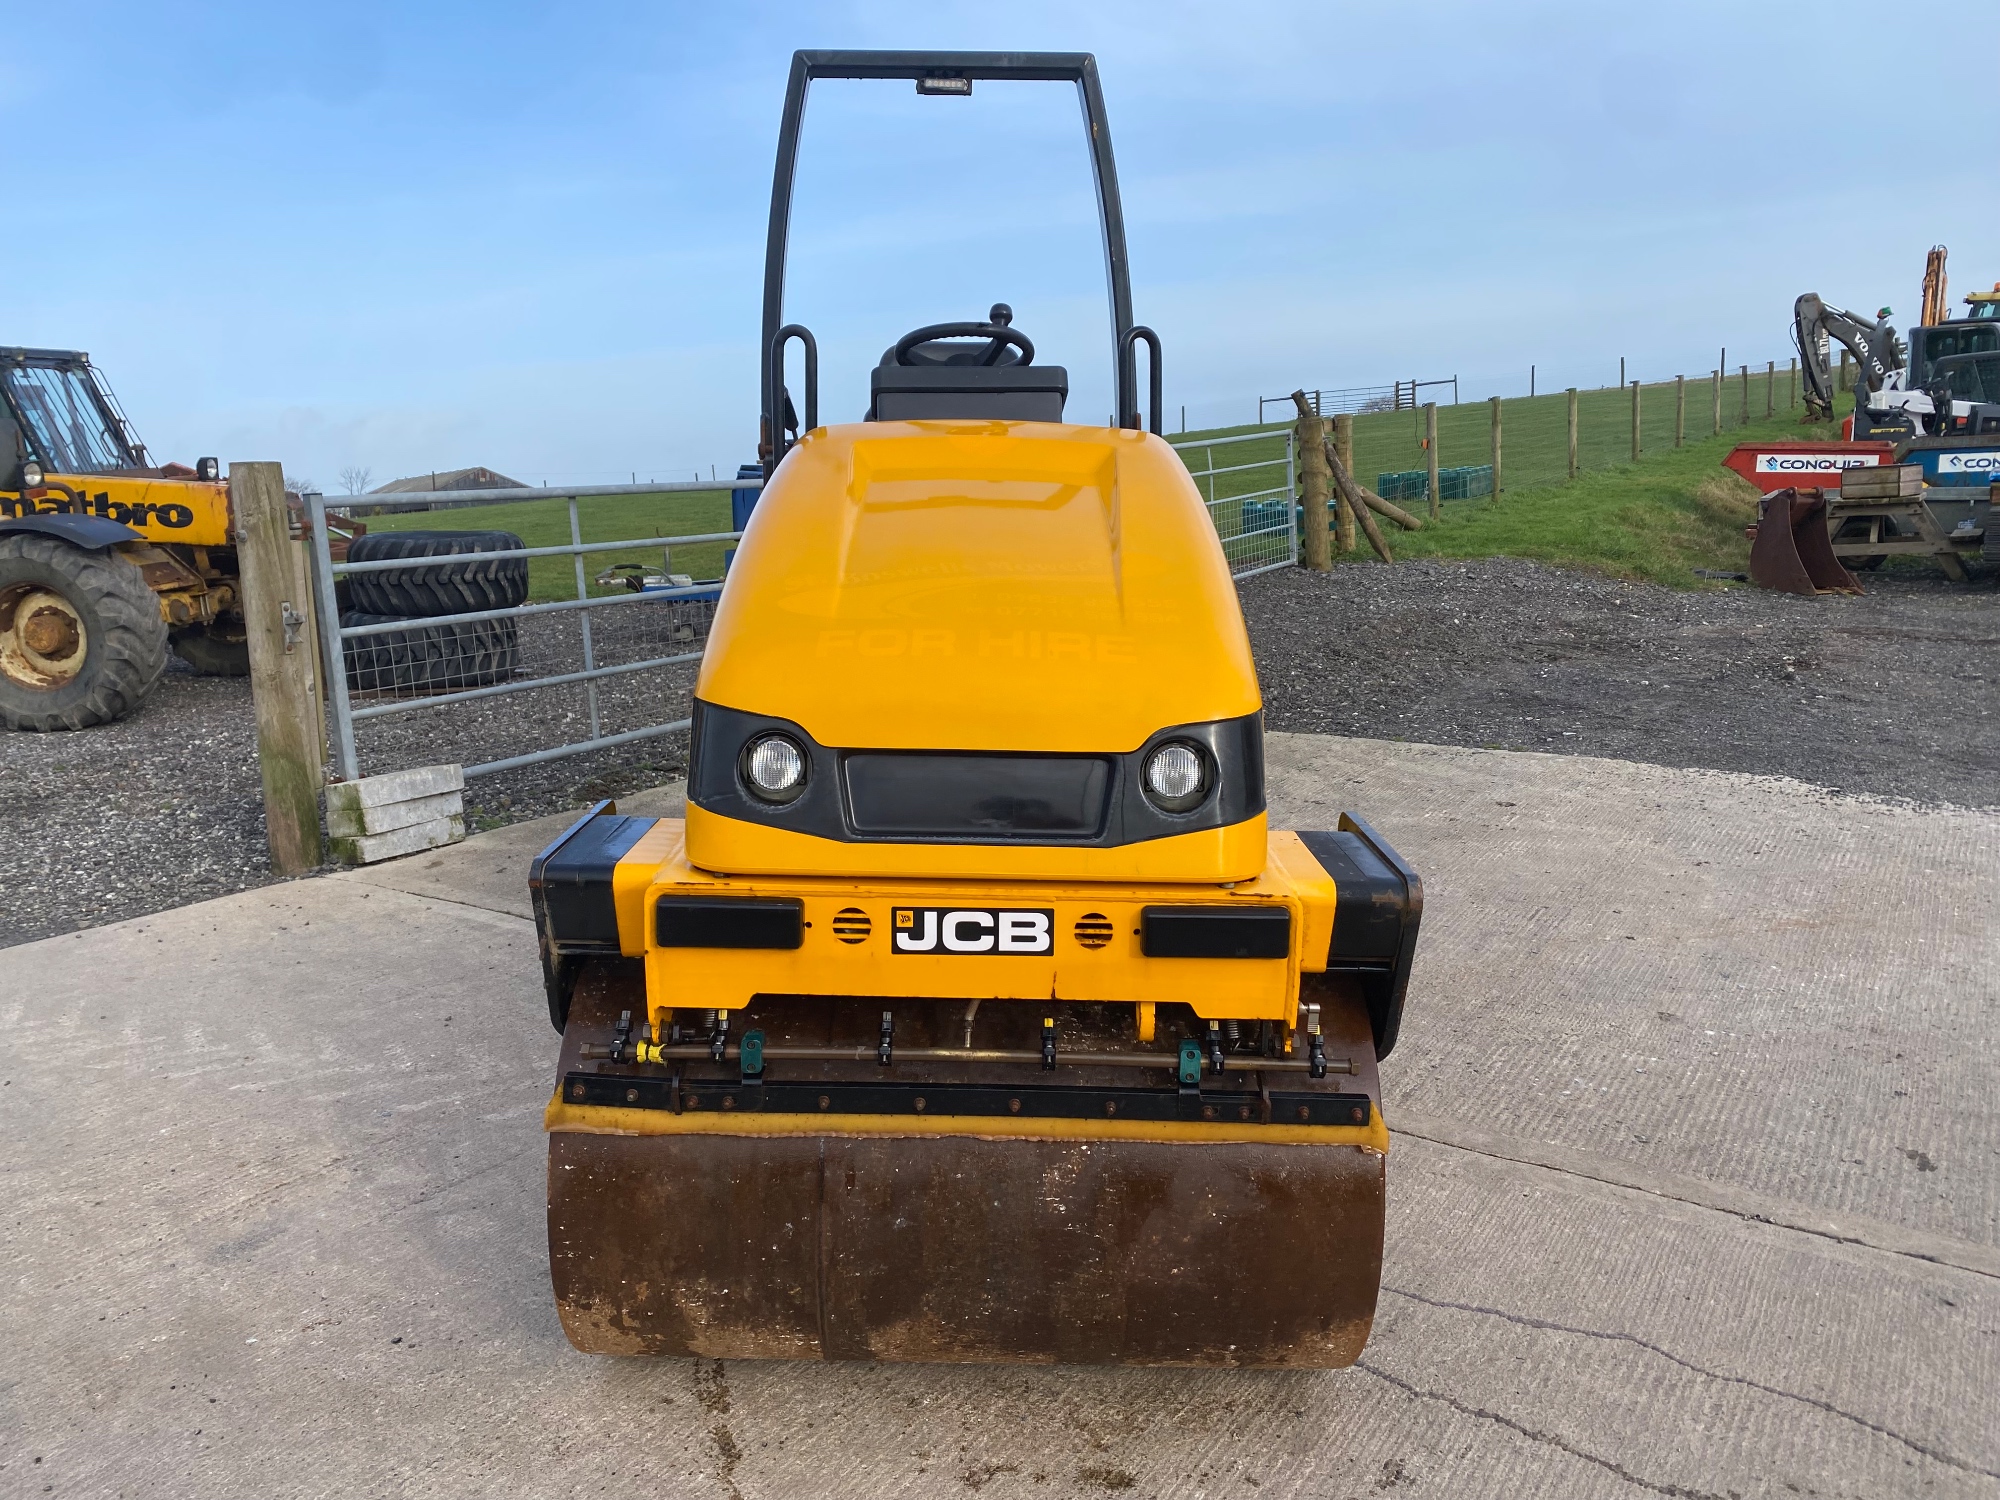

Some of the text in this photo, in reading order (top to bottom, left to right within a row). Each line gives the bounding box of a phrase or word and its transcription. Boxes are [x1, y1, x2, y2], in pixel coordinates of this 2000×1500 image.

[815, 628, 1138, 663] FOR HIRE
[896, 911, 1051, 952] JCB
